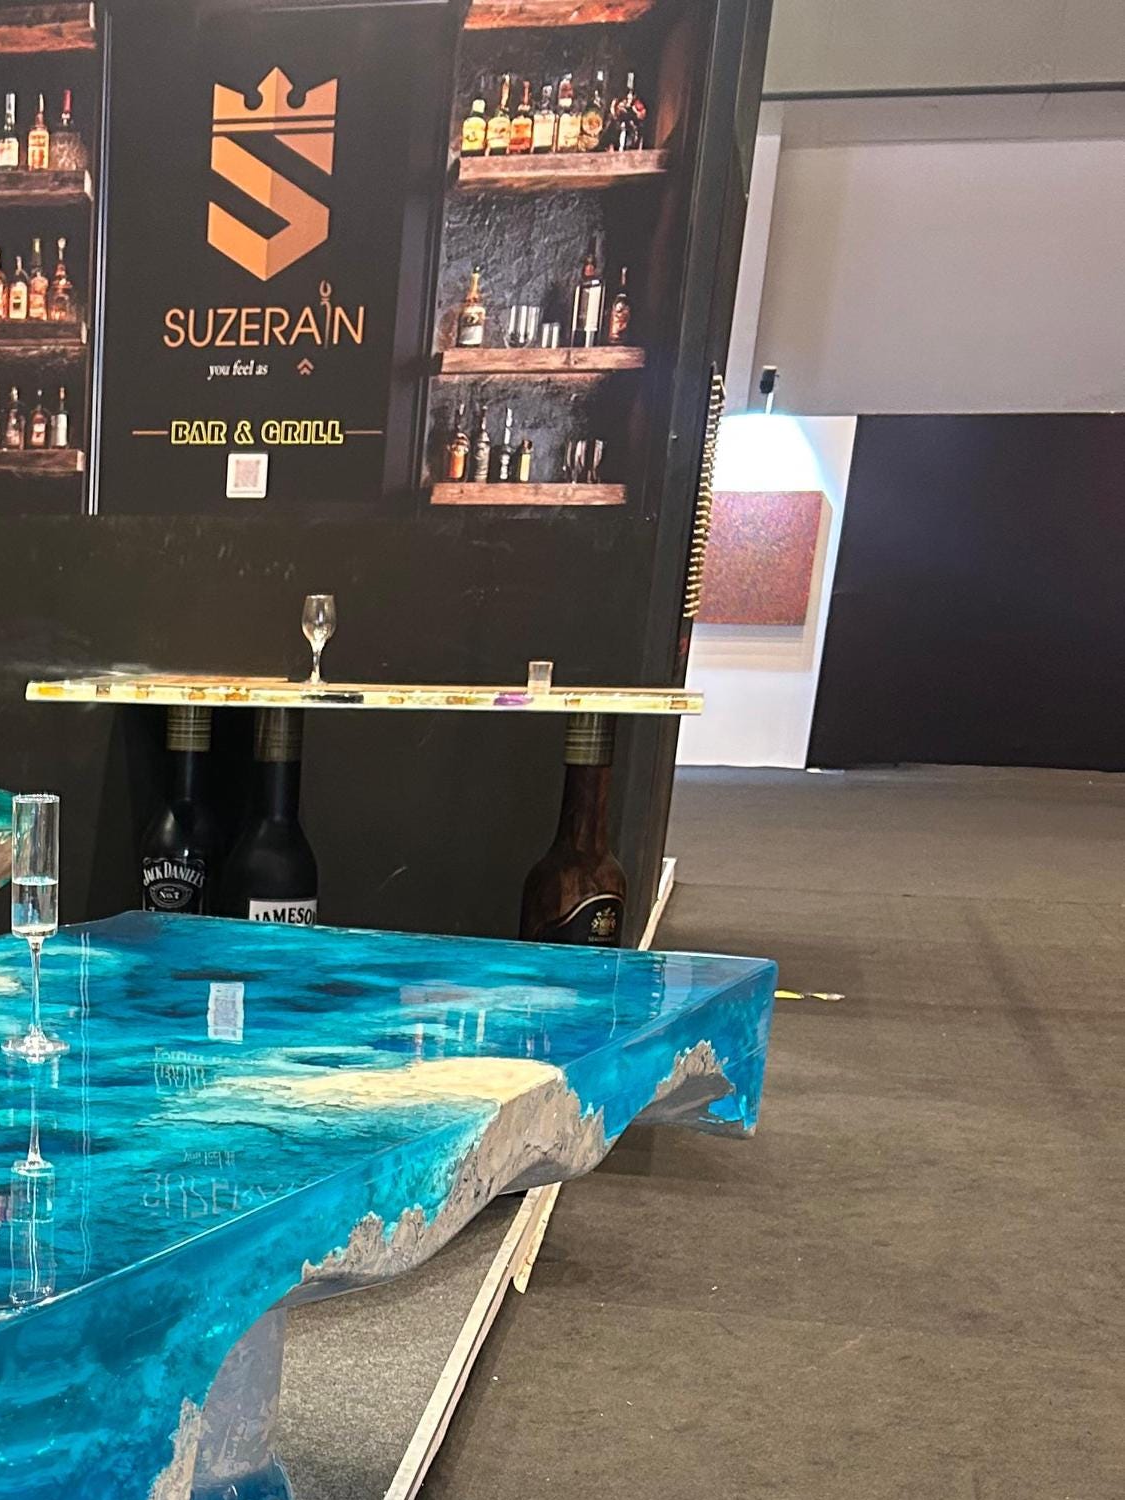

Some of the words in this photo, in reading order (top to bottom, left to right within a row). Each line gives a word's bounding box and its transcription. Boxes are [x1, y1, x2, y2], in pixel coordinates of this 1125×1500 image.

[163, 281, 365, 349] SUZERAIN
[207, 363, 230, 380] you
[232, 360, 254, 376] feel
[256, 363, 269, 376] as
[171, 420, 227, 445] BAR
[234, 420, 254, 445] &
[261, 420, 344, 445] GRILL
